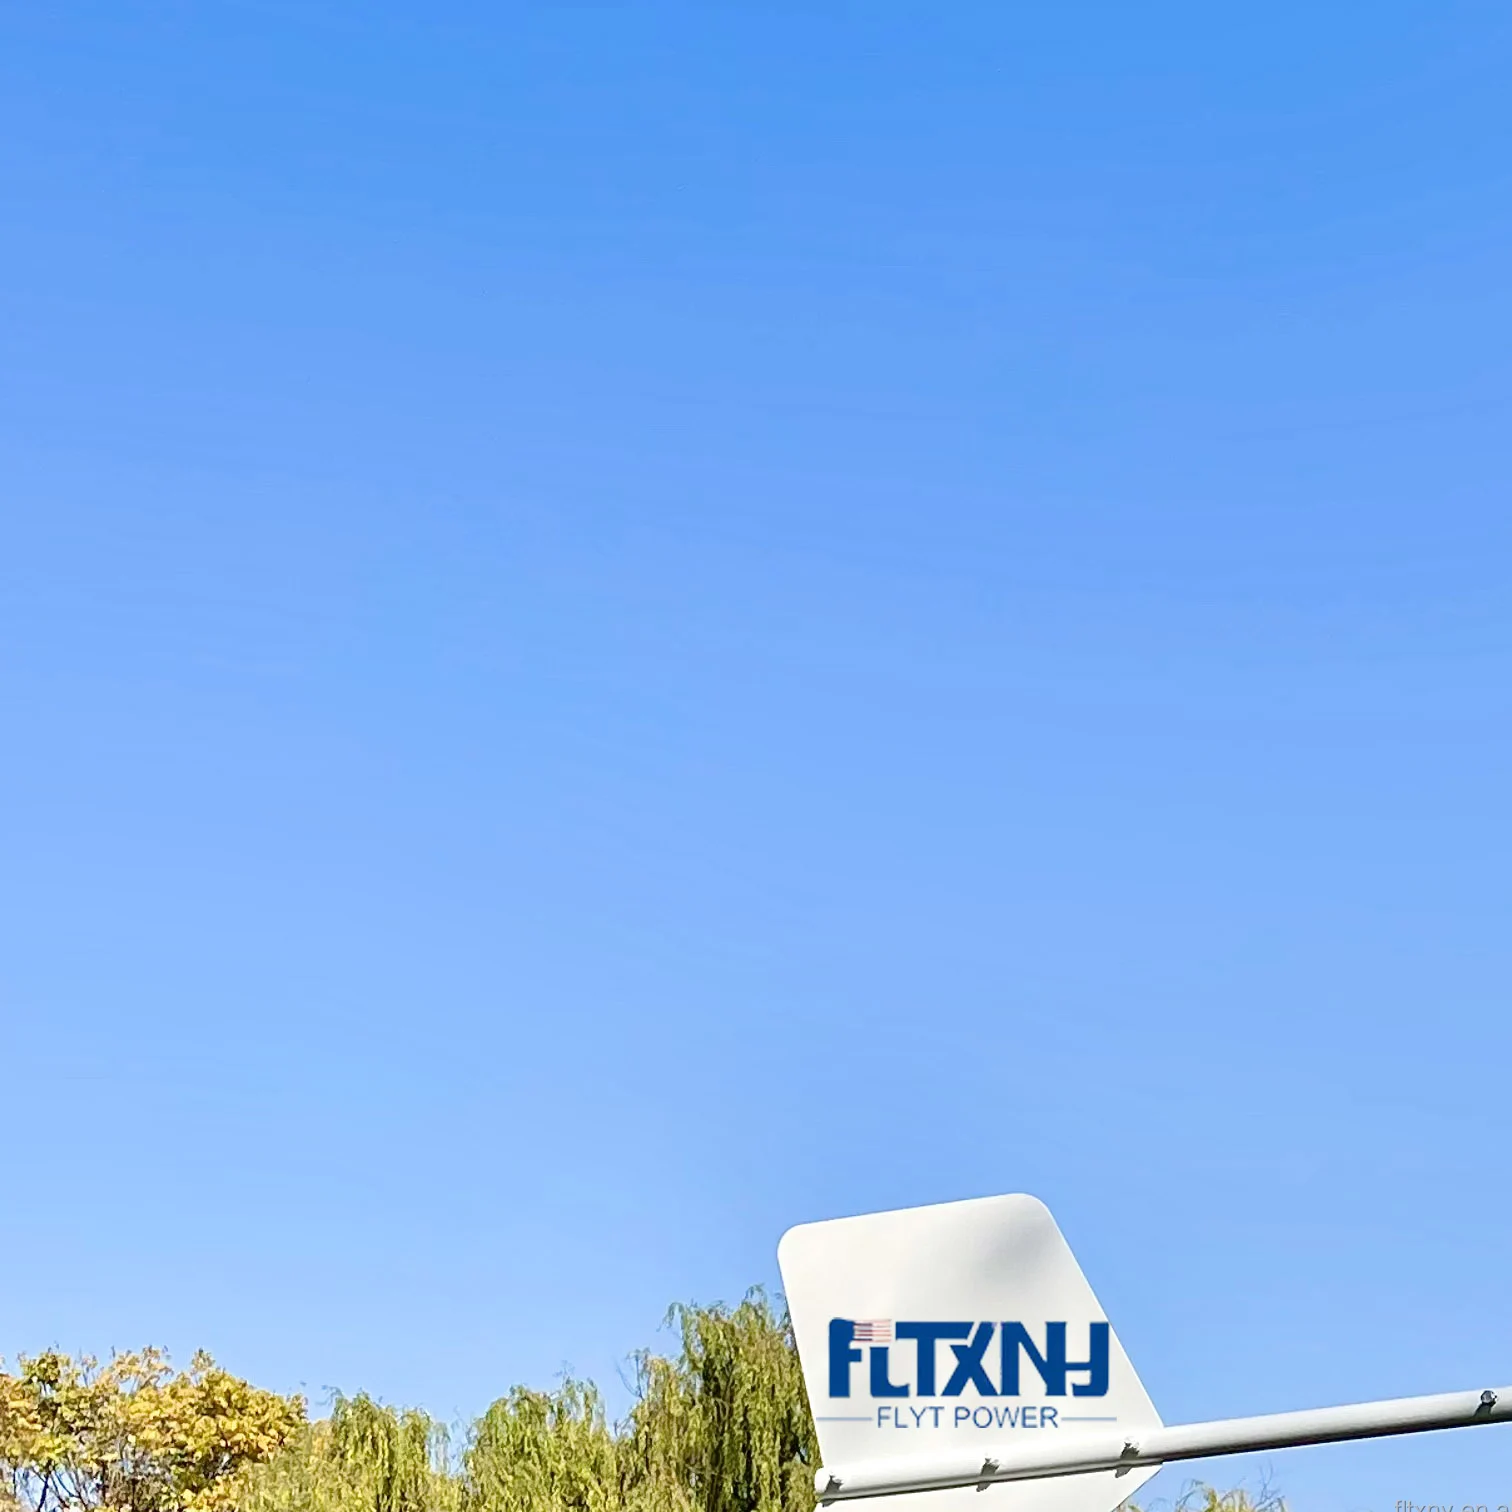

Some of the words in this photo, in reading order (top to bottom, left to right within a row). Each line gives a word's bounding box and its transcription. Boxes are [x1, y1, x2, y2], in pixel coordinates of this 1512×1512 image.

[828, 1317, 1109, 1398] FLTXNY
[877, 1406, 944, 1428] FLYT
[954, 1406, 1058, 1428] POWER
